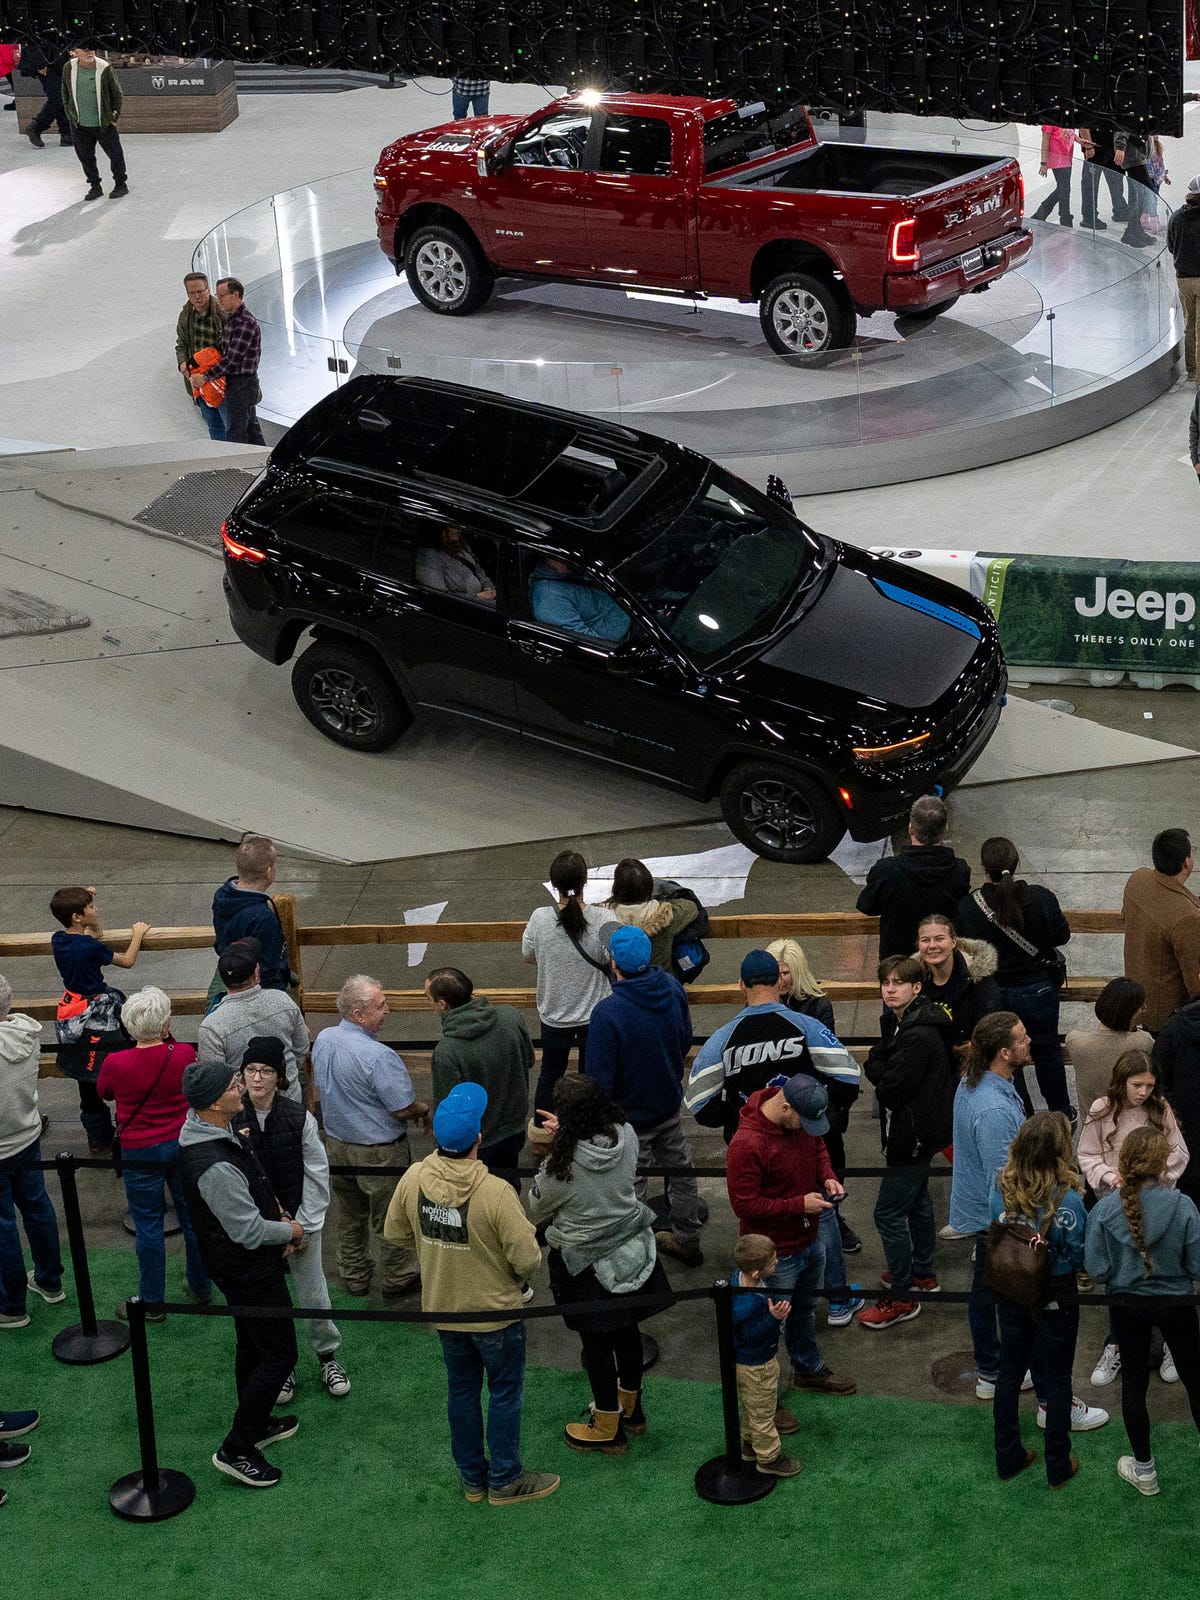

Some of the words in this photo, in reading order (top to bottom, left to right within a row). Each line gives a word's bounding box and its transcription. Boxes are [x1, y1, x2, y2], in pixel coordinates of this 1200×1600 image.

[945, 194, 1001, 228] RAM
[496, 229, 524, 237] RAM
[1075, 577, 1196, 630] Jeep
[1074, 634, 1125, 645] THERE'S
[1130, 636, 1164, 647] ONLY
[1169, 639, 1195, 648] ONE
[723, 1035, 806, 1077] LIONS
[422, 1205, 448, 1217] NORTH
[430, 1214, 448, 1224] FACE
